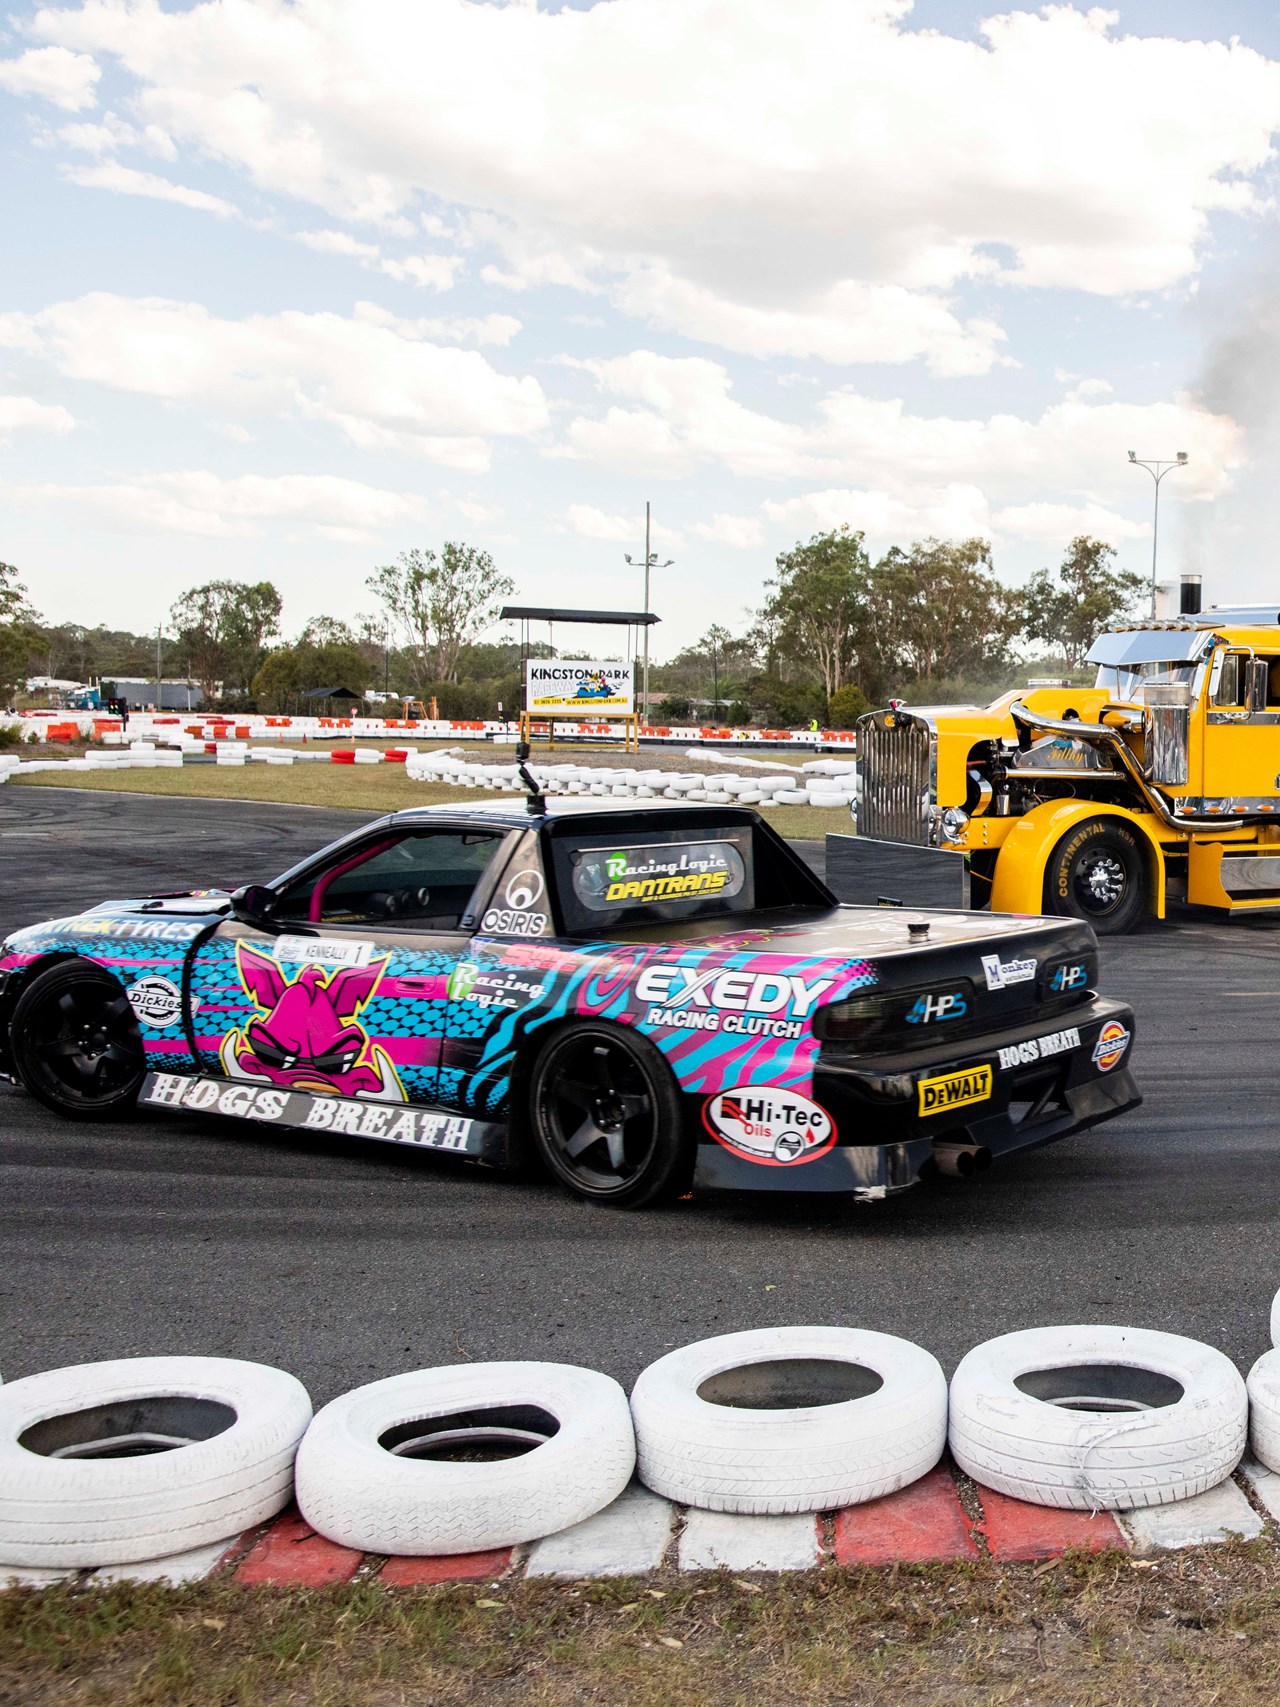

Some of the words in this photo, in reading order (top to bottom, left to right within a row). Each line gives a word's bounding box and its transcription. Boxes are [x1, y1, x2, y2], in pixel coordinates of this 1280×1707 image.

[531, 668, 593, 680] KINGSTON
[599, 670, 629, 679] PARK
[532, 681, 576, 697] RACEWAY
[1059, 823, 1105, 897] CONTINENTAL
[605, 871, 729, 901] DANTRANS
[115, 919, 206, 940] TYRES
[482, 909, 547, 936] OSIRIS
[456, 963, 548, 999] Racing
[634, 965, 836, 1017] EXEDY
[1059, 964, 1088, 991] HPS
[130, 991, 183, 1010] Dickies
[453, 982, 519, 1008] Logic
[922, 993, 968, 1023] HPS
[647, 1007, 720, 1033] RACING
[722, 1014, 802, 1040] CLUTCH
[997, 1041, 1039, 1070] HOGS
[1038, 1028, 1082, 1058] BREATH
[149, 1072, 290, 1120] HOGS
[304, 1096, 474, 1152] BREATH
[745, 1098, 823, 1127] Hi-Tec
[744, 1123, 771, 1137] Oils
